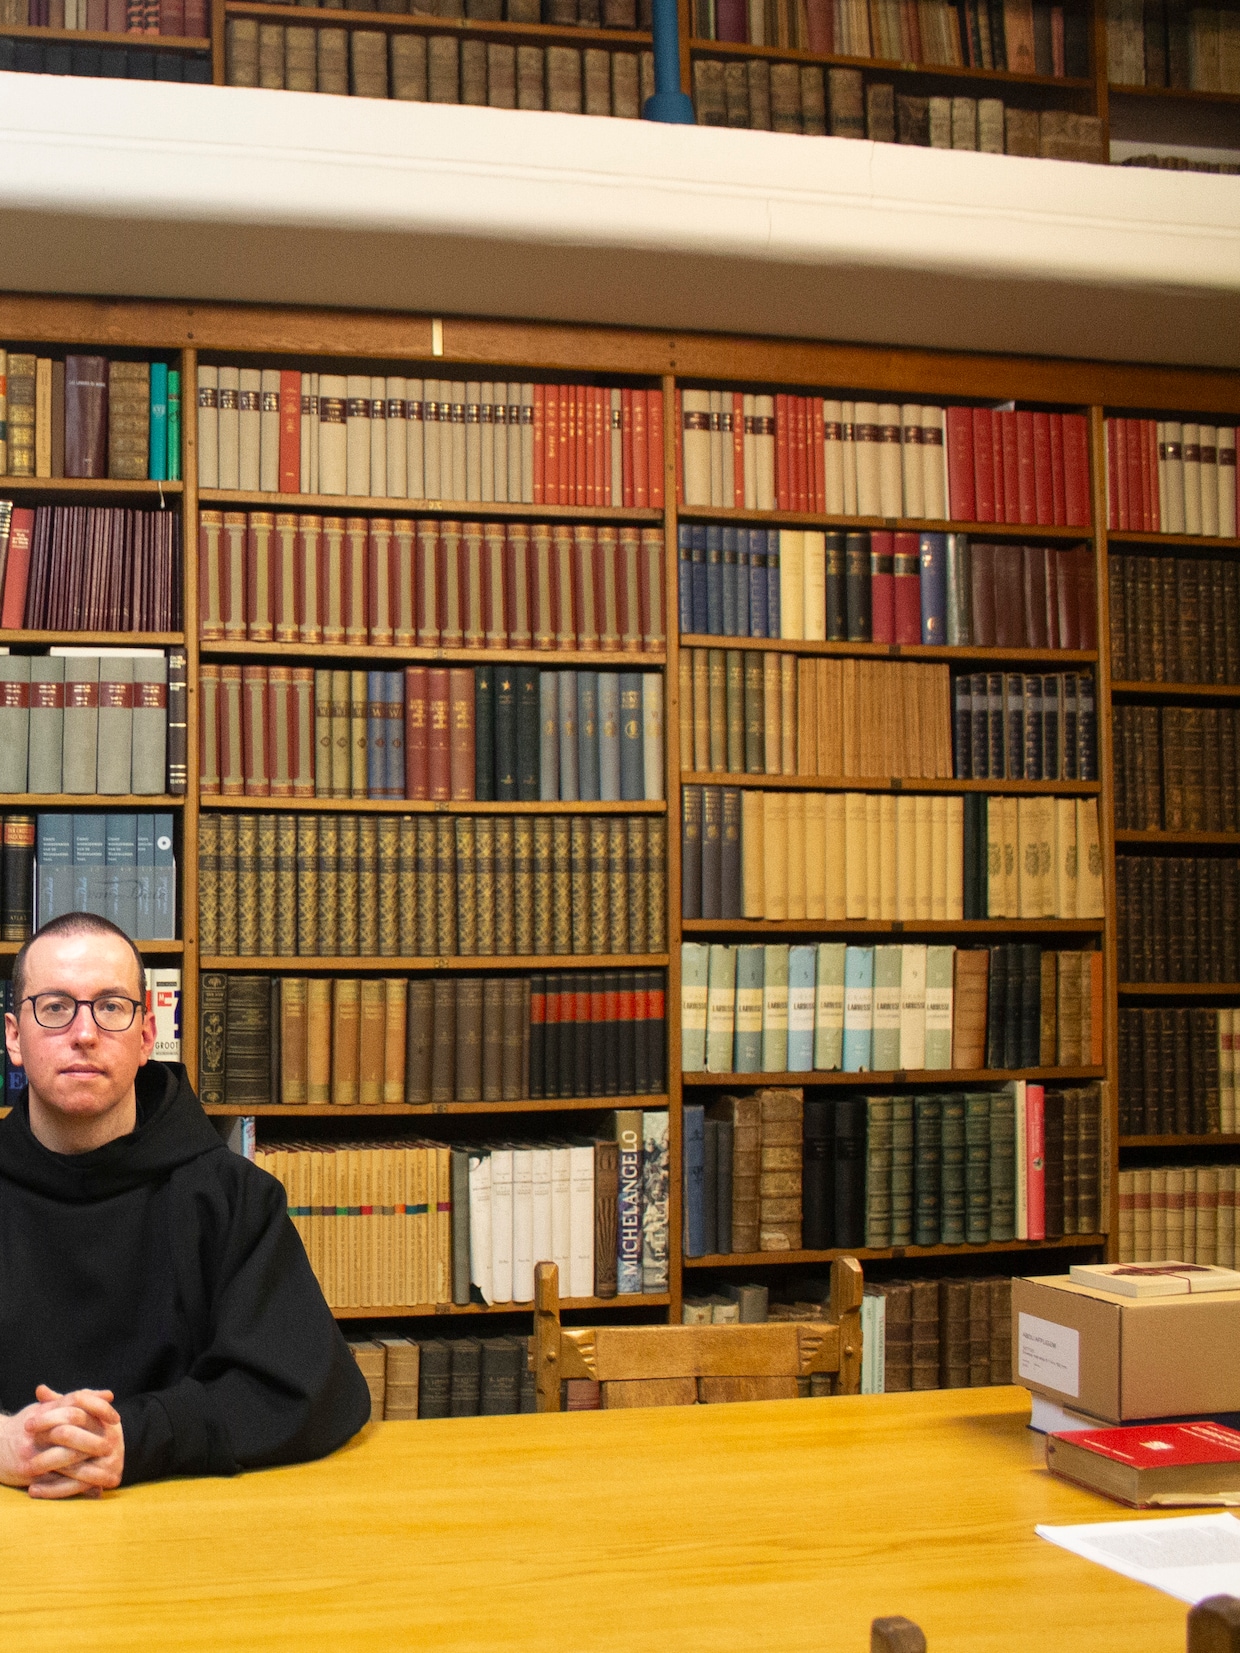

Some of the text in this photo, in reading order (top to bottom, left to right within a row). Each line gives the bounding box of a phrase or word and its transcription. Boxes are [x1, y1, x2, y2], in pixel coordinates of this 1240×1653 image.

[432, 319, 444, 357] I
[155, 1041, 179, 1050] GROOT
[621, 1129, 638, 1276] MICHELANGELO
